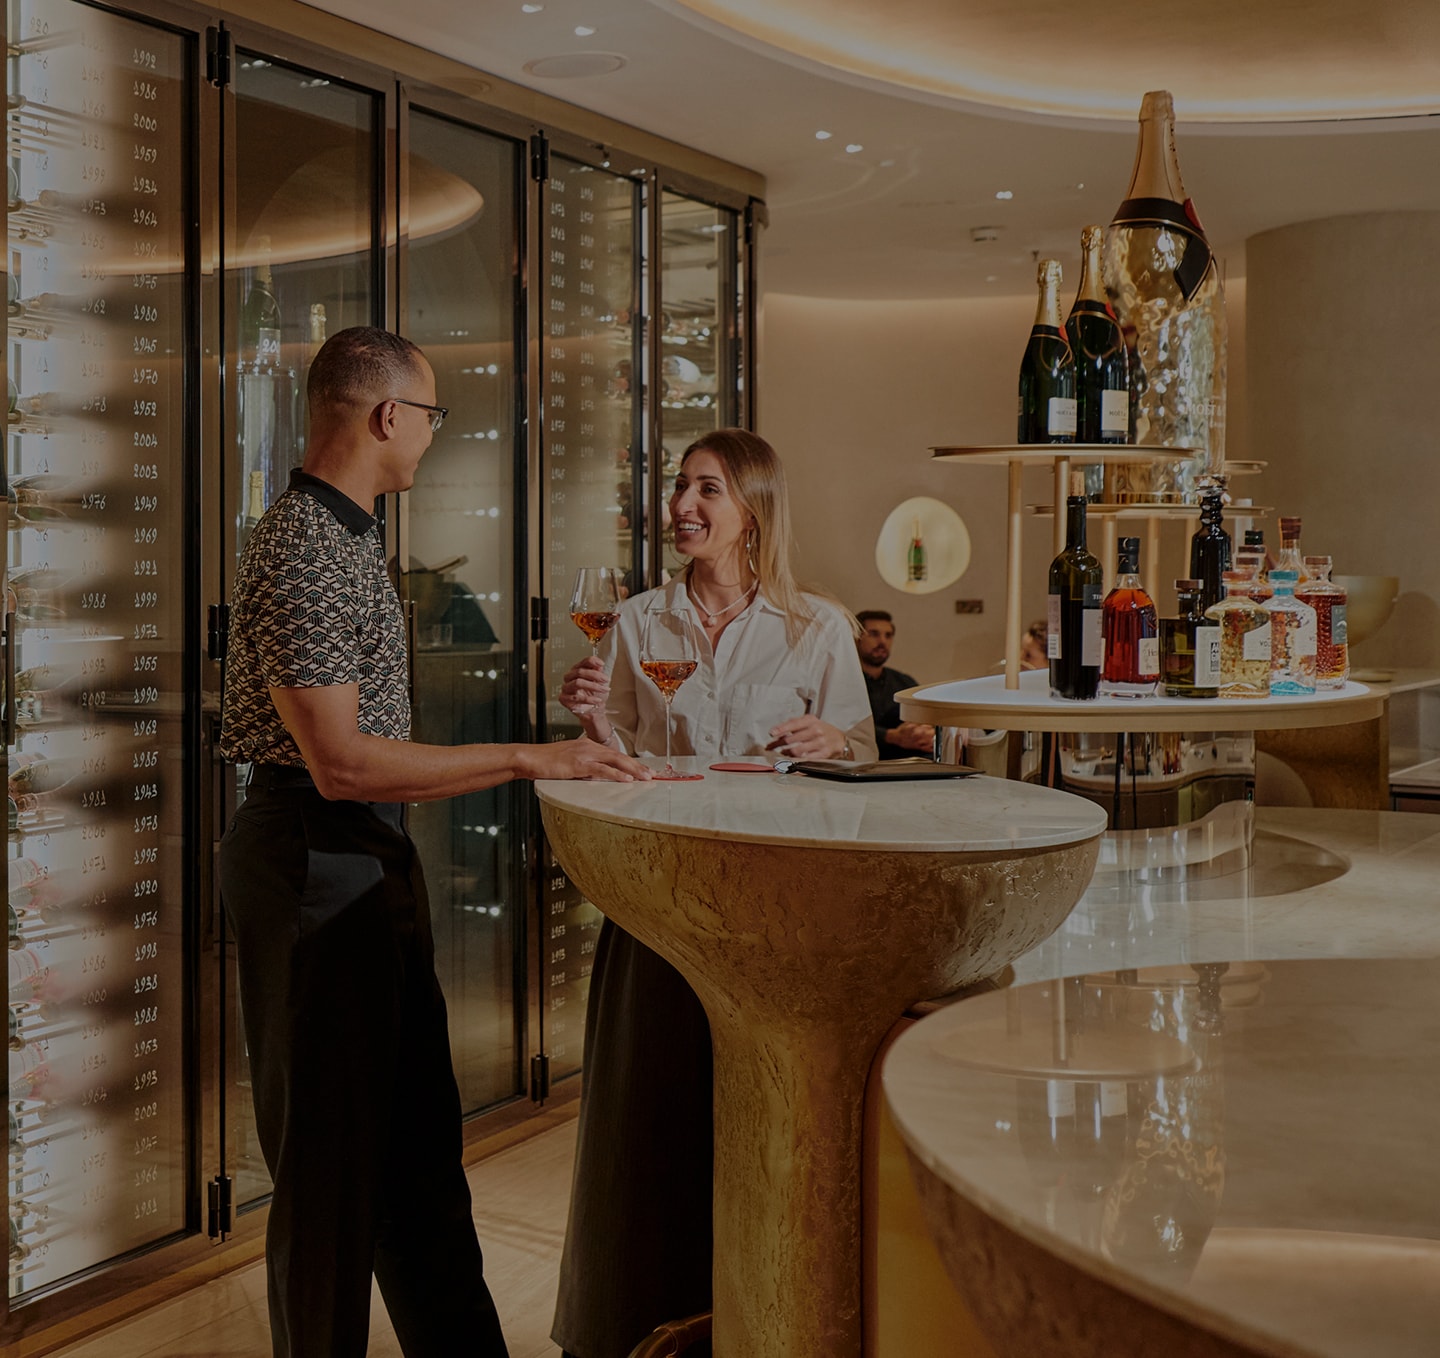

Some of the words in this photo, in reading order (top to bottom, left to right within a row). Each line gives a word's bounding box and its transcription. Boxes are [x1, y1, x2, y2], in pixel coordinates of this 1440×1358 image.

[133, 48, 156, 69] 1992
[134, 81, 157, 101] 1986
[133, 112, 157, 132] 2000
[134, 144, 157, 164] 1959
[81, 164, 107, 182] 1999
[133, 176, 158, 196] 1934
[81, 199, 107, 216] 1973
[133, 208, 158, 227] 1964
[132, 240, 158, 260] 1996
[132, 272, 158, 291] 1975
[81, 299, 107, 315] 1962
[134, 304, 158, 322] 1980
[134, 336, 158, 353] 1945
[133, 368, 158, 385] 1970
[81, 395, 107, 412] 1978
[134, 400, 157, 417] 1952
[133, 431, 158, 448] 2004
[133, 463, 158, 480] 2003
[81, 493, 107, 510] 1976
[134, 495, 158, 512] 1949
[134, 527, 158, 544] 1969
[134, 559, 158, 576] 1921
[81, 592, 107, 608] 1988
[134, 591, 158, 608] 1999
[134, 623, 158, 640] 1973
[134, 655, 158, 672] 1955
[81, 690, 107, 708] 2002
[133, 686, 158, 704] 1990
[134, 719, 157, 737] 1962
[81, 755, 107, 774] 1966
[133, 750, 159, 768] 1985
[81, 790, 107, 808] 1981
[134, 783, 158, 801] 1943
[134, 814, 158, 833] 1978
[81, 855, 107, 874] 1971
[134, 847, 158, 865] 1995
[134, 879, 158, 898] 1920
[134, 910, 158, 930] 1976
[134, 942, 158, 962] 1998
[81, 954, 107, 974] 1986
[134, 973, 158, 994] 1938
[81, 988, 107, 1006] 2000
[134, 1006, 158, 1026] 1988
[134, 1038, 158, 1058] 1953
[134, 1069, 158, 1091] 1993
[134, 1101, 158, 1121] 2002
[135, 1164, 158, 1187] 1966
[135, 1198, 158, 1220] 1981
